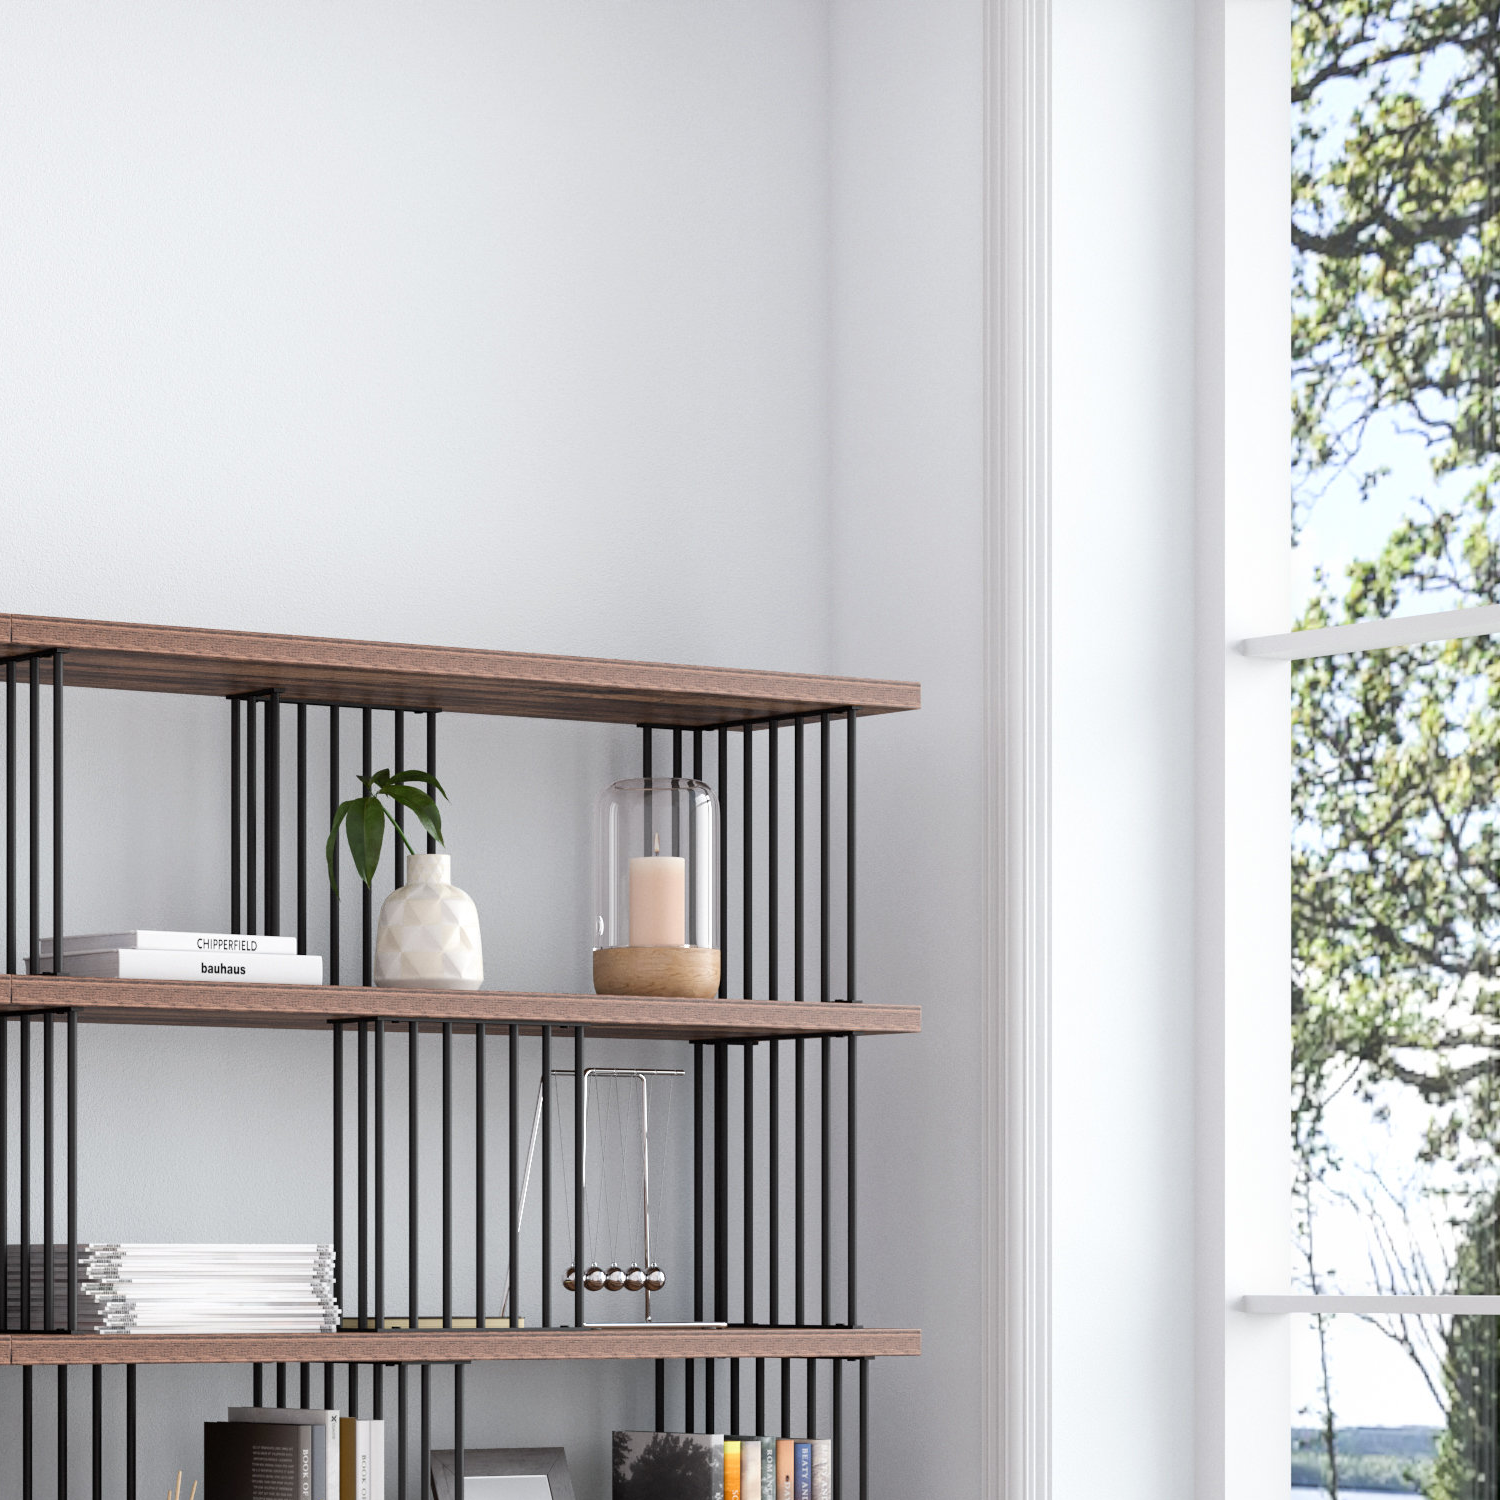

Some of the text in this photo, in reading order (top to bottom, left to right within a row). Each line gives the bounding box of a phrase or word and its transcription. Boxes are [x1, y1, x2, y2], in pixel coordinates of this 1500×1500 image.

[197, 938, 257, 951] CHIPPERFIELD
[201, 963, 246, 975] bauhaus
[303, 1482, 309, 1496] OF
